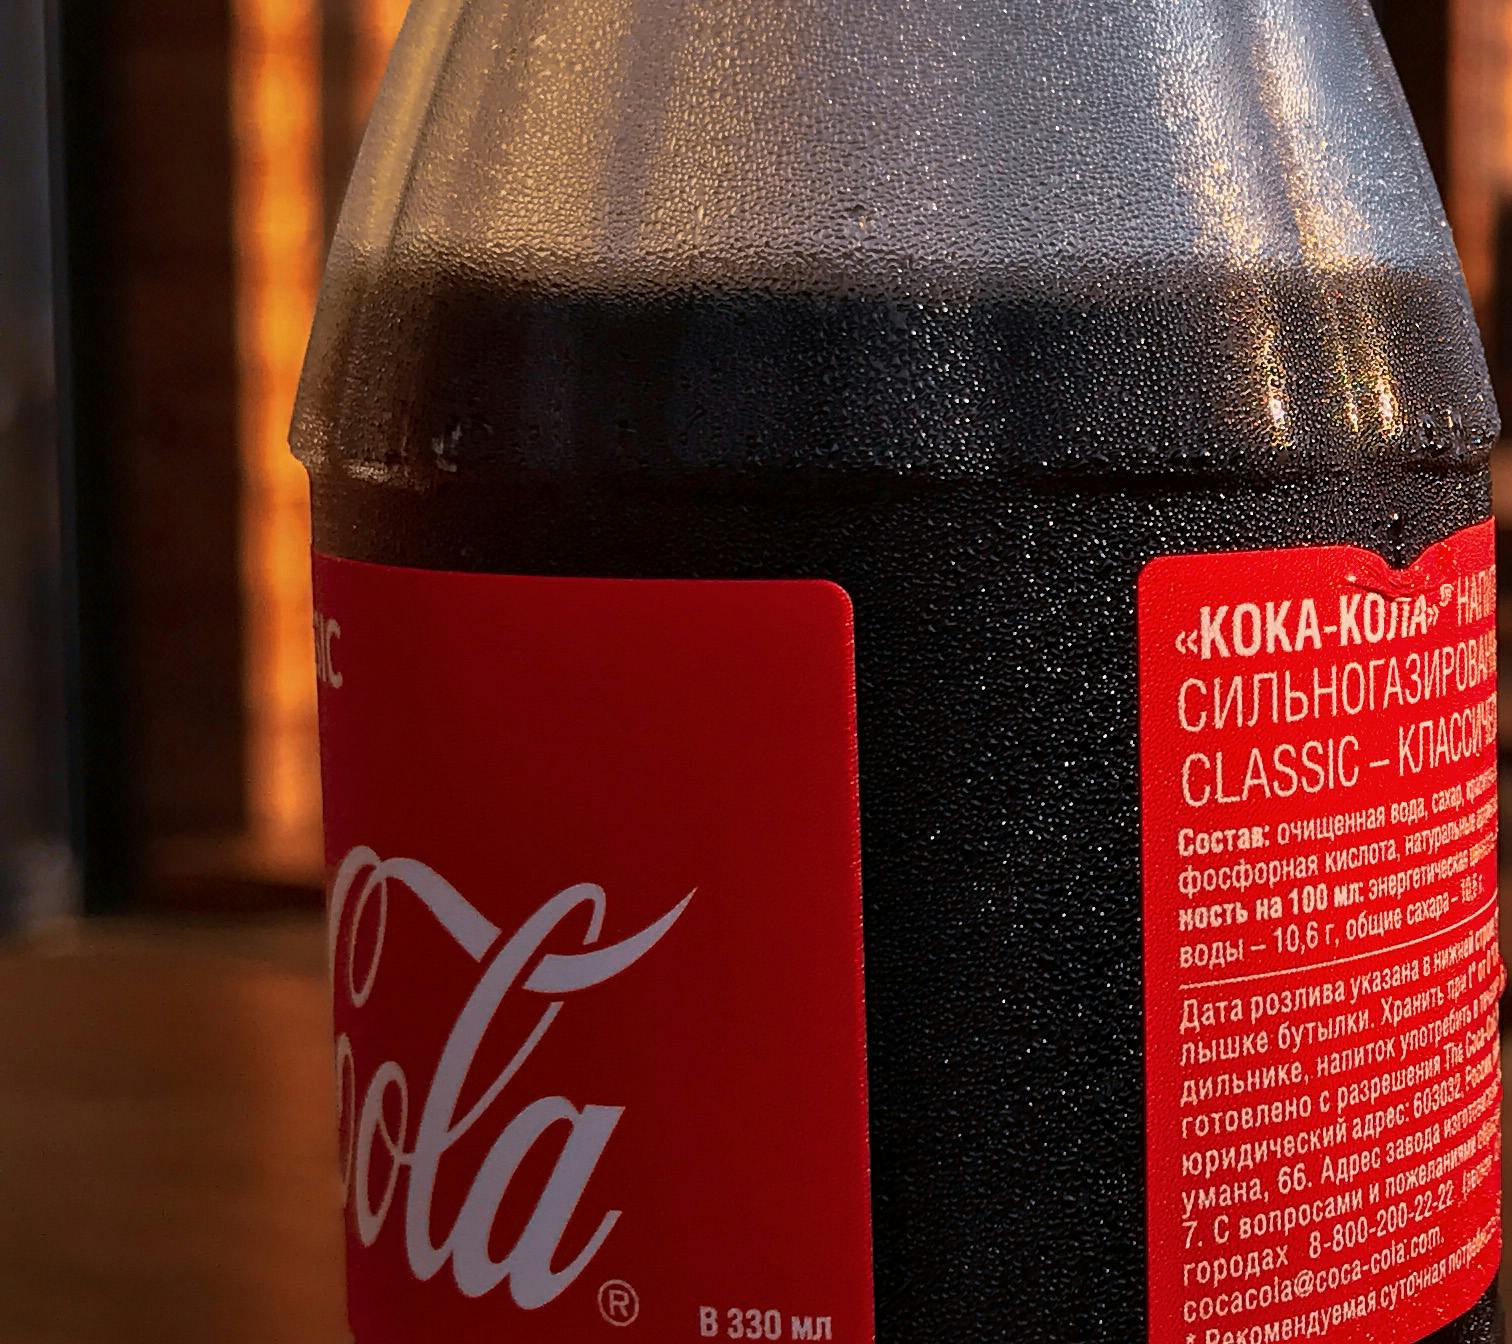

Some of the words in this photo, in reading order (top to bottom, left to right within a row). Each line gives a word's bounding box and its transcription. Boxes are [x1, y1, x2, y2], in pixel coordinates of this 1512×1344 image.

[1181, 735, 1359, 807] CLASSIC
[1178, 825, 1270, 857] Состав:
[1277, 806, 1385, 845] очищенная
[1390, 797, 1428, 826] вода,
[1431, 784, 1464, 814] сахар,
[1178, 855, 1318, 900] фосфорная
[1325, 839, 1400, 873] кислота,
[1179, 901, 1248, 931] ность
[1256, 896, 1282, 921] на
[1288, 882, 1328, 915] 100
[1333, 881, 1364, 907] мл:
[1179, 938, 1244, 970] воды
[1272, 921, 1318, 955] 10,6
[1346, 908, 1402, 941] общие
[1406, 892, 1449, 925] сахара
[1179, 999, 1243, 1035] Дата
[1250, 980, 1345, 1025] розлива
[1350, 959, 1419, 1004] указана
[1423, 956, 1431, 976] в
[1180, 1030, 1269, 1066] лышке
[1278, 1009, 1375, 1053] бутылки.
[1380, 986, 1445, 1027] Хранить
[1180, 1061, 1309, 1106] дильнике,
[1317, 1037, 1396, 1077] напиток
[1400, 1005, 1471, 1061] употребить
[1181, 1095, 1312, 1139] готовлено
[1320, 1090, 1330, 1113] с
[1338, 1056, 1441, 1114] разрешения
[1182, 1116, 1347, 1179] юридический
[1352, 1102, 1409, 1141] адрес:
[1413, 1073, 1464, 1118] 603032,
[1182, 1178, 1269, 1219] умана,
[1277, 1163, 1312, 1194] 66.
[1321, 1147, 1380, 1185] Адрес
[1386, 1123, 1440, 1163] завода
[1182, 1221, 1203, 1249] 7.
[1240, 1188, 1363, 1239] вопросами
[1369, 1182, 1379, 1205] и
[1184, 1244, 1288, 1288] городах
[1309, 1180, 1454, 1258] 8-800-200-22-22
[700, 1306, 718, 1337] В
[727, 1308, 782, 1340] 330
[791, 1316, 832, 1341] мл
[1380, 1259, 1446, 1310] суточная
